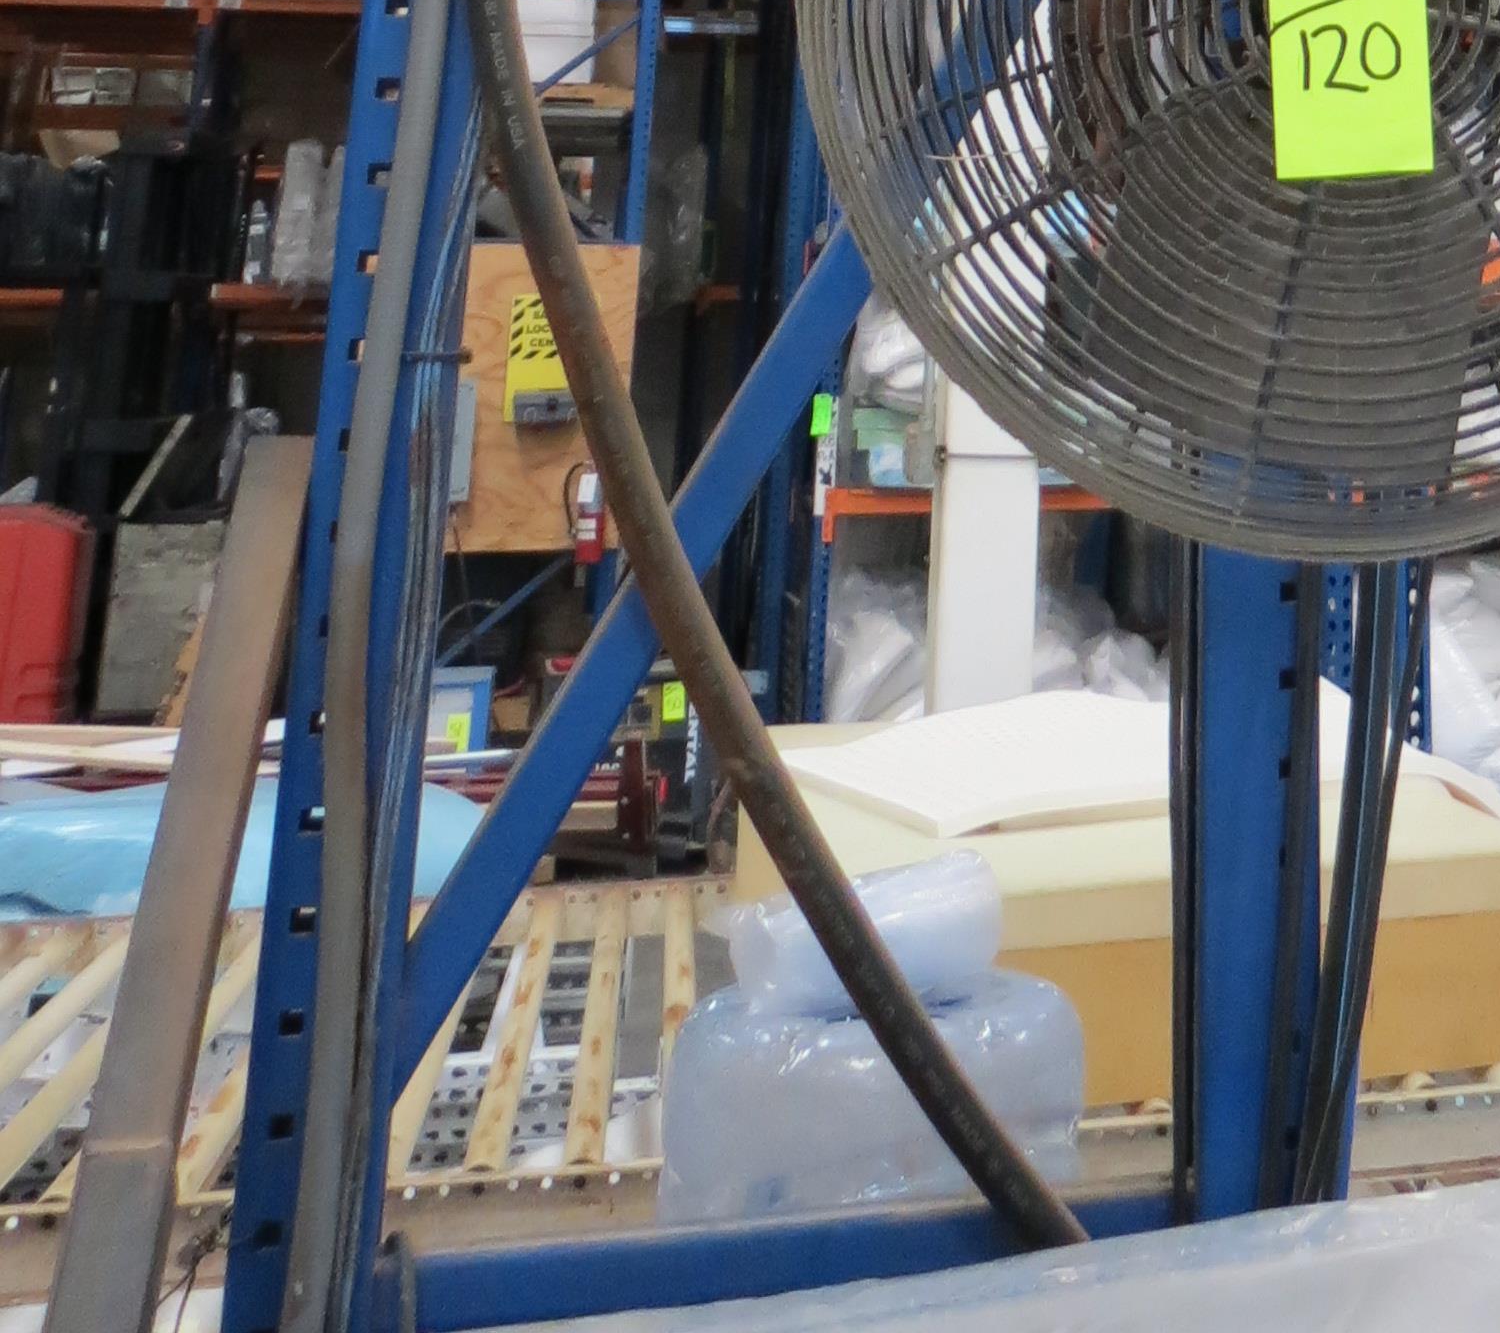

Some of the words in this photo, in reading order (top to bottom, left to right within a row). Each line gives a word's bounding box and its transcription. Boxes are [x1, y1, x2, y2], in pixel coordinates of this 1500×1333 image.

[488, 30, 509, 81] MADE
[1299, 20, 1402, 93] 120
[499, 88, 515, 106] IN
[505, 113, 526, 150] USA
